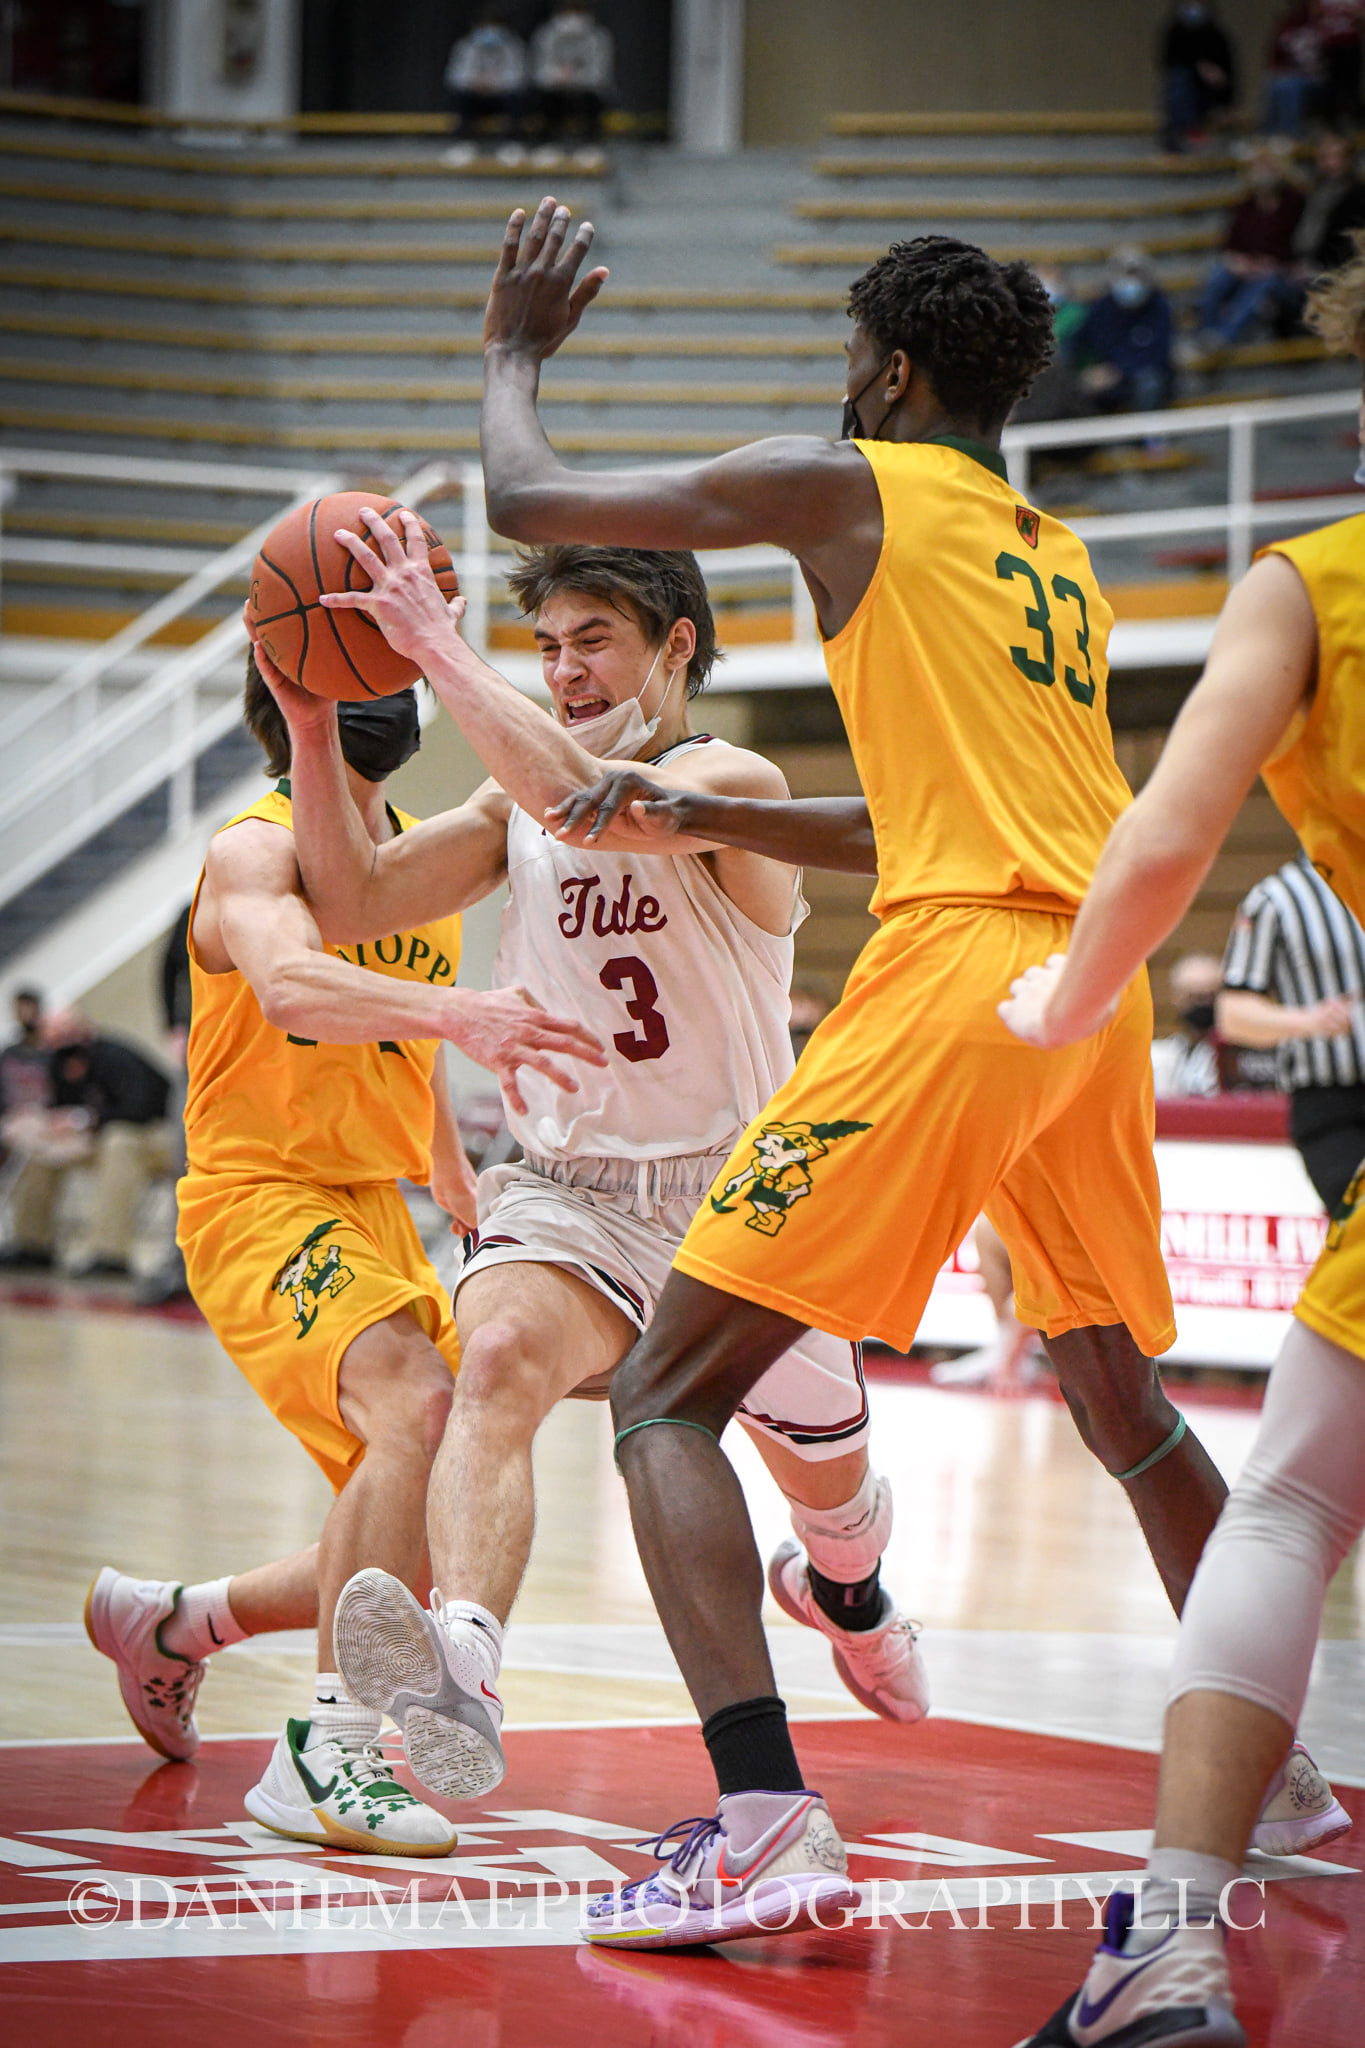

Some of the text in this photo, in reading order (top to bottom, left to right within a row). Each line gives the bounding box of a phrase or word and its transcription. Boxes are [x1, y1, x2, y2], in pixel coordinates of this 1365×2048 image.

[995, 551, 1096, 709] 33
[558, 874, 668, 939] Tide
[599, 956, 670, 1063] 3
